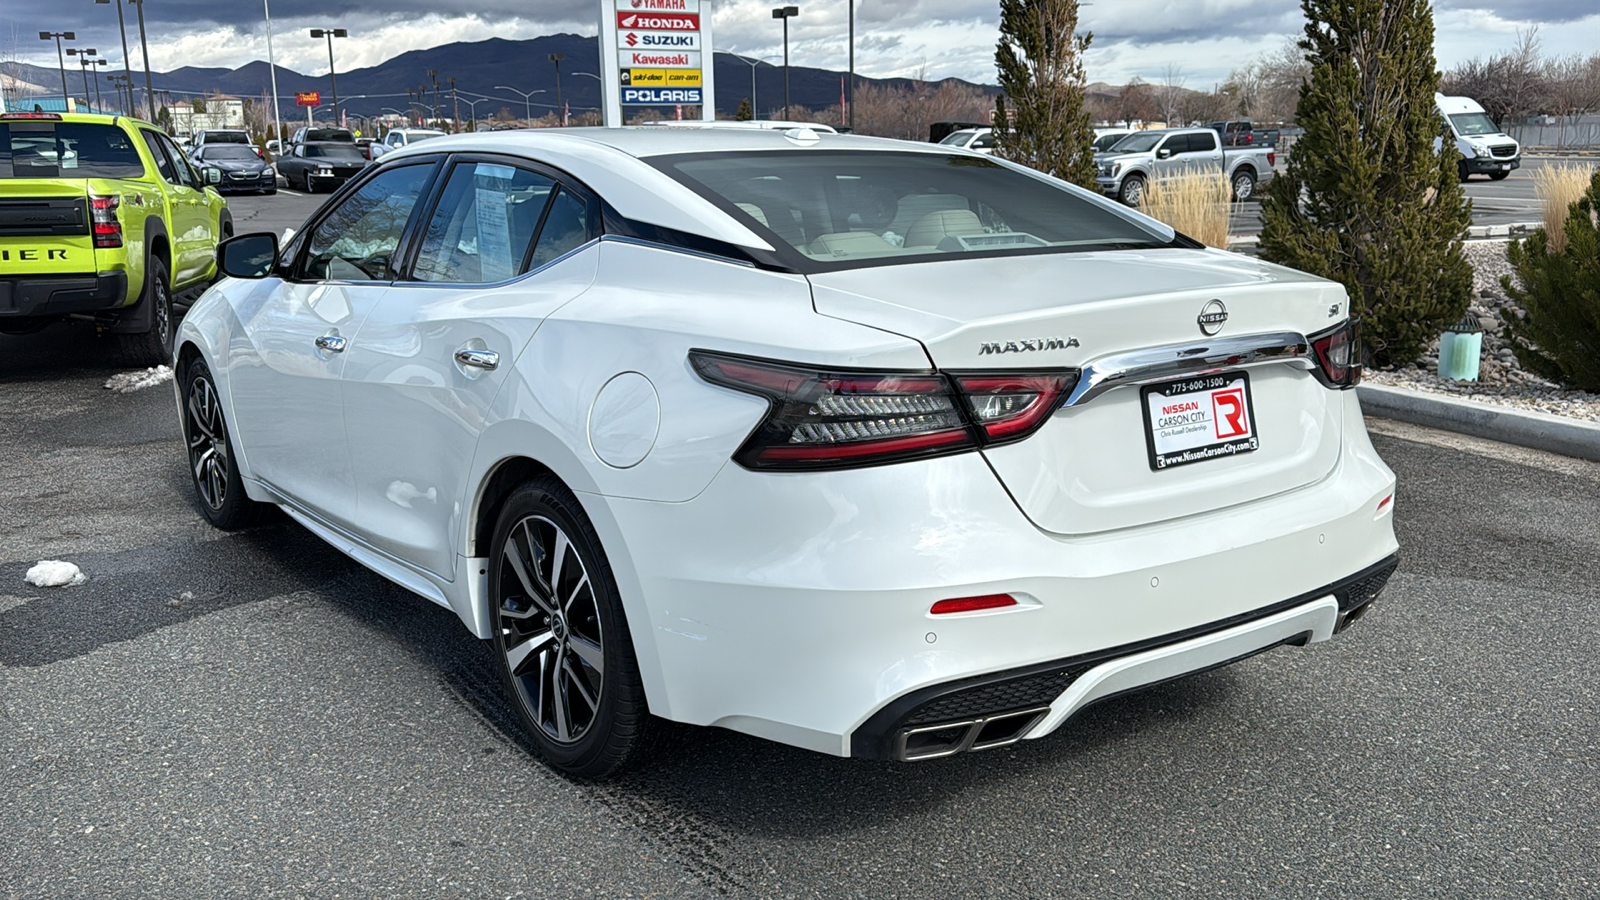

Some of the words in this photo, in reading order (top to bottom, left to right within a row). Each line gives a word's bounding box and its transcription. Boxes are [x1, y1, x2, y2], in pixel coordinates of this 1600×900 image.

[644, 0, 686, 9] YAMAHA
[637, 18, 696, 29] HONDA
[642, 35, 693, 46] SUZUKI
[632, 53, 689, 65] Kawasaki
[625, 90, 700, 102] POLARIS
[1199, 313, 1228, 323] NISSAN
[978, 336, 1081, 356] MAXIMA
[1171, 377, 1224, 394] 775-600-1500
[1162, 401, 1199, 415] NISSAN
[1158, 413, 1189, 428] CARSON
[1190, 411, 1206, 422] CITY
[1160, 430, 1172, 438] Chris
[1185, 424, 1208, 434] Dealership
[1165, 441, 1250, 465] www.NissanCarsonCity.com
